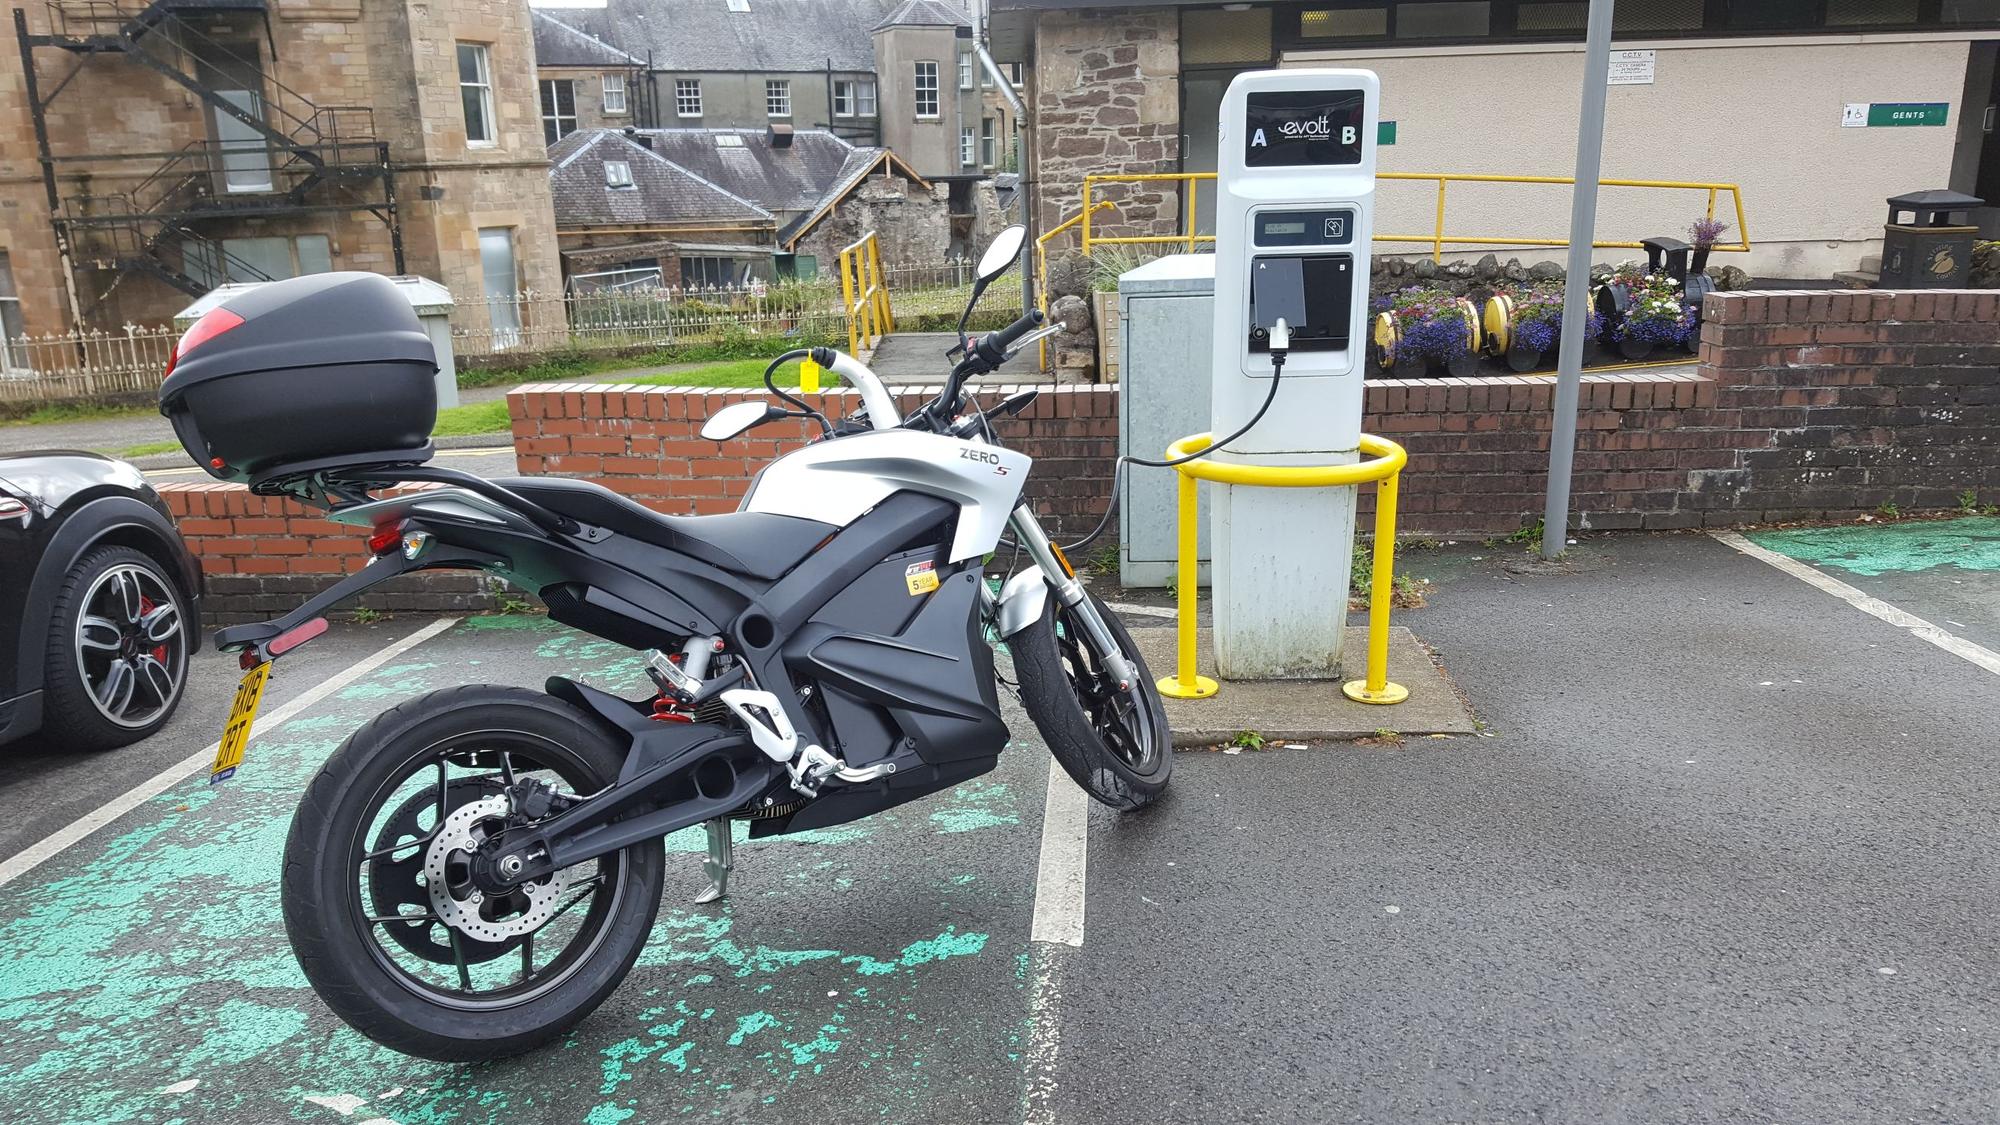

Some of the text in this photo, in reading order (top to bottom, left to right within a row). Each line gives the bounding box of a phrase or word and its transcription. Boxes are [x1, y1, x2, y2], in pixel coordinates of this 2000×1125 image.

[1892, 111, 1925, 119] GENTS
[1278, 115, 1331, 134] evolt
[1251, 128, 1267, 147] A
[1342, 126, 1357, 145] B
[960, 447, 1000, 465] ZERO
[993, 466, 1012, 476] S
[912, 580, 920, 591] 5
